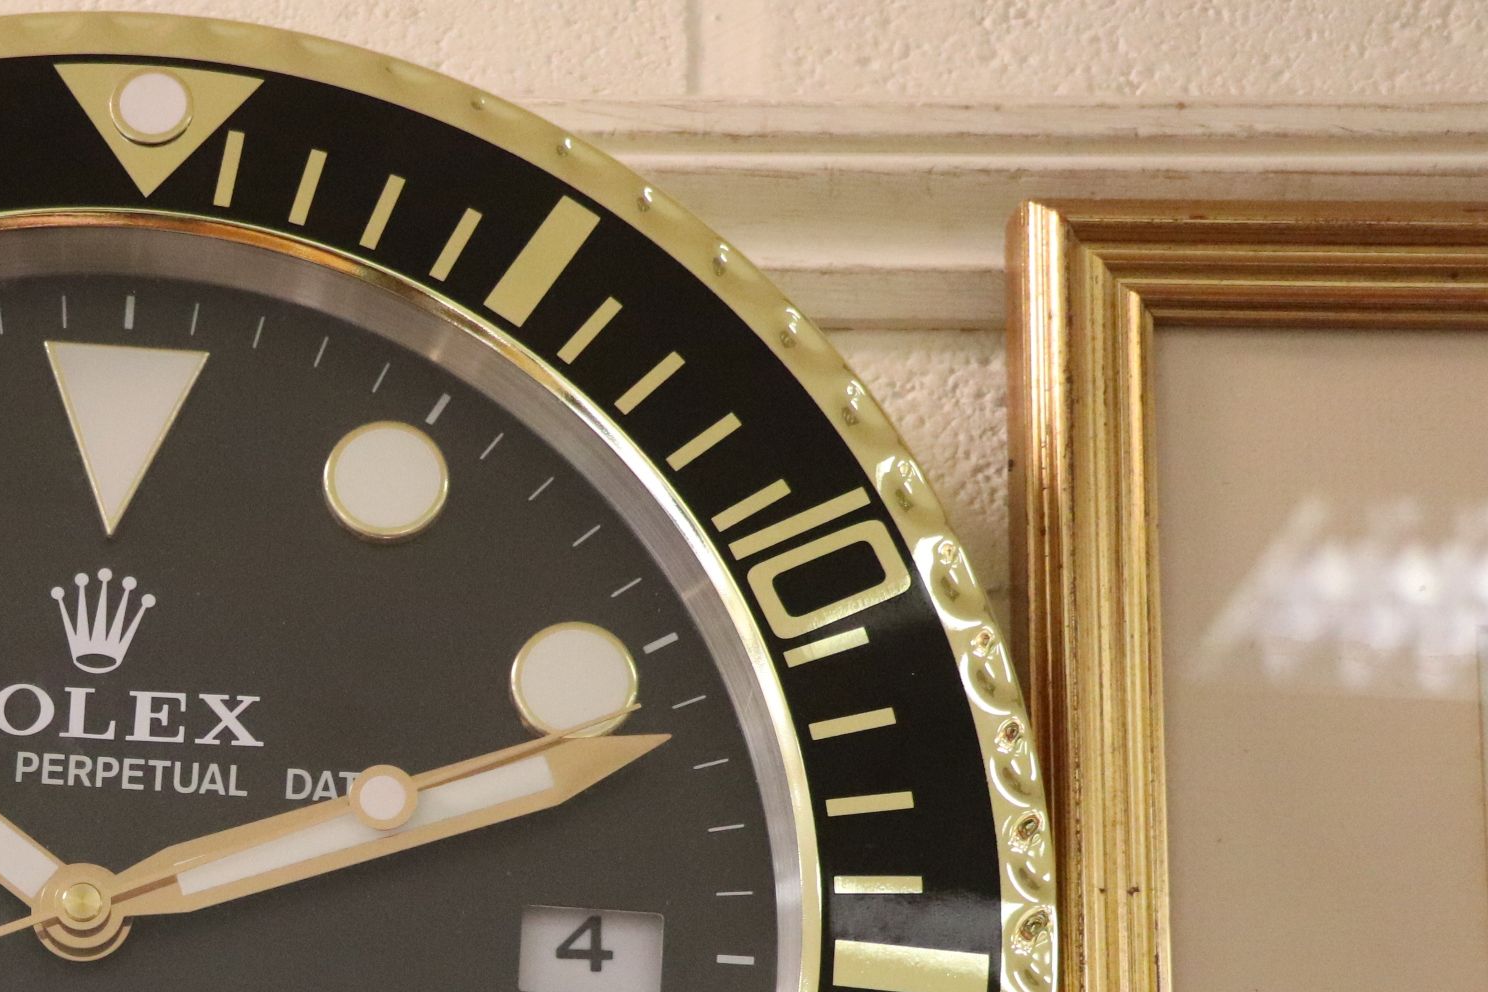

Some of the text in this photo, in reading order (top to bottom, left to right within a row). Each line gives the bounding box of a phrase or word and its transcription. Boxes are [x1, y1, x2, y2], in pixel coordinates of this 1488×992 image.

[728, 486, 911, 640] 10
[15, 751, 248, 797] PERPETUAL
[556, 915, 613, 972] 4
